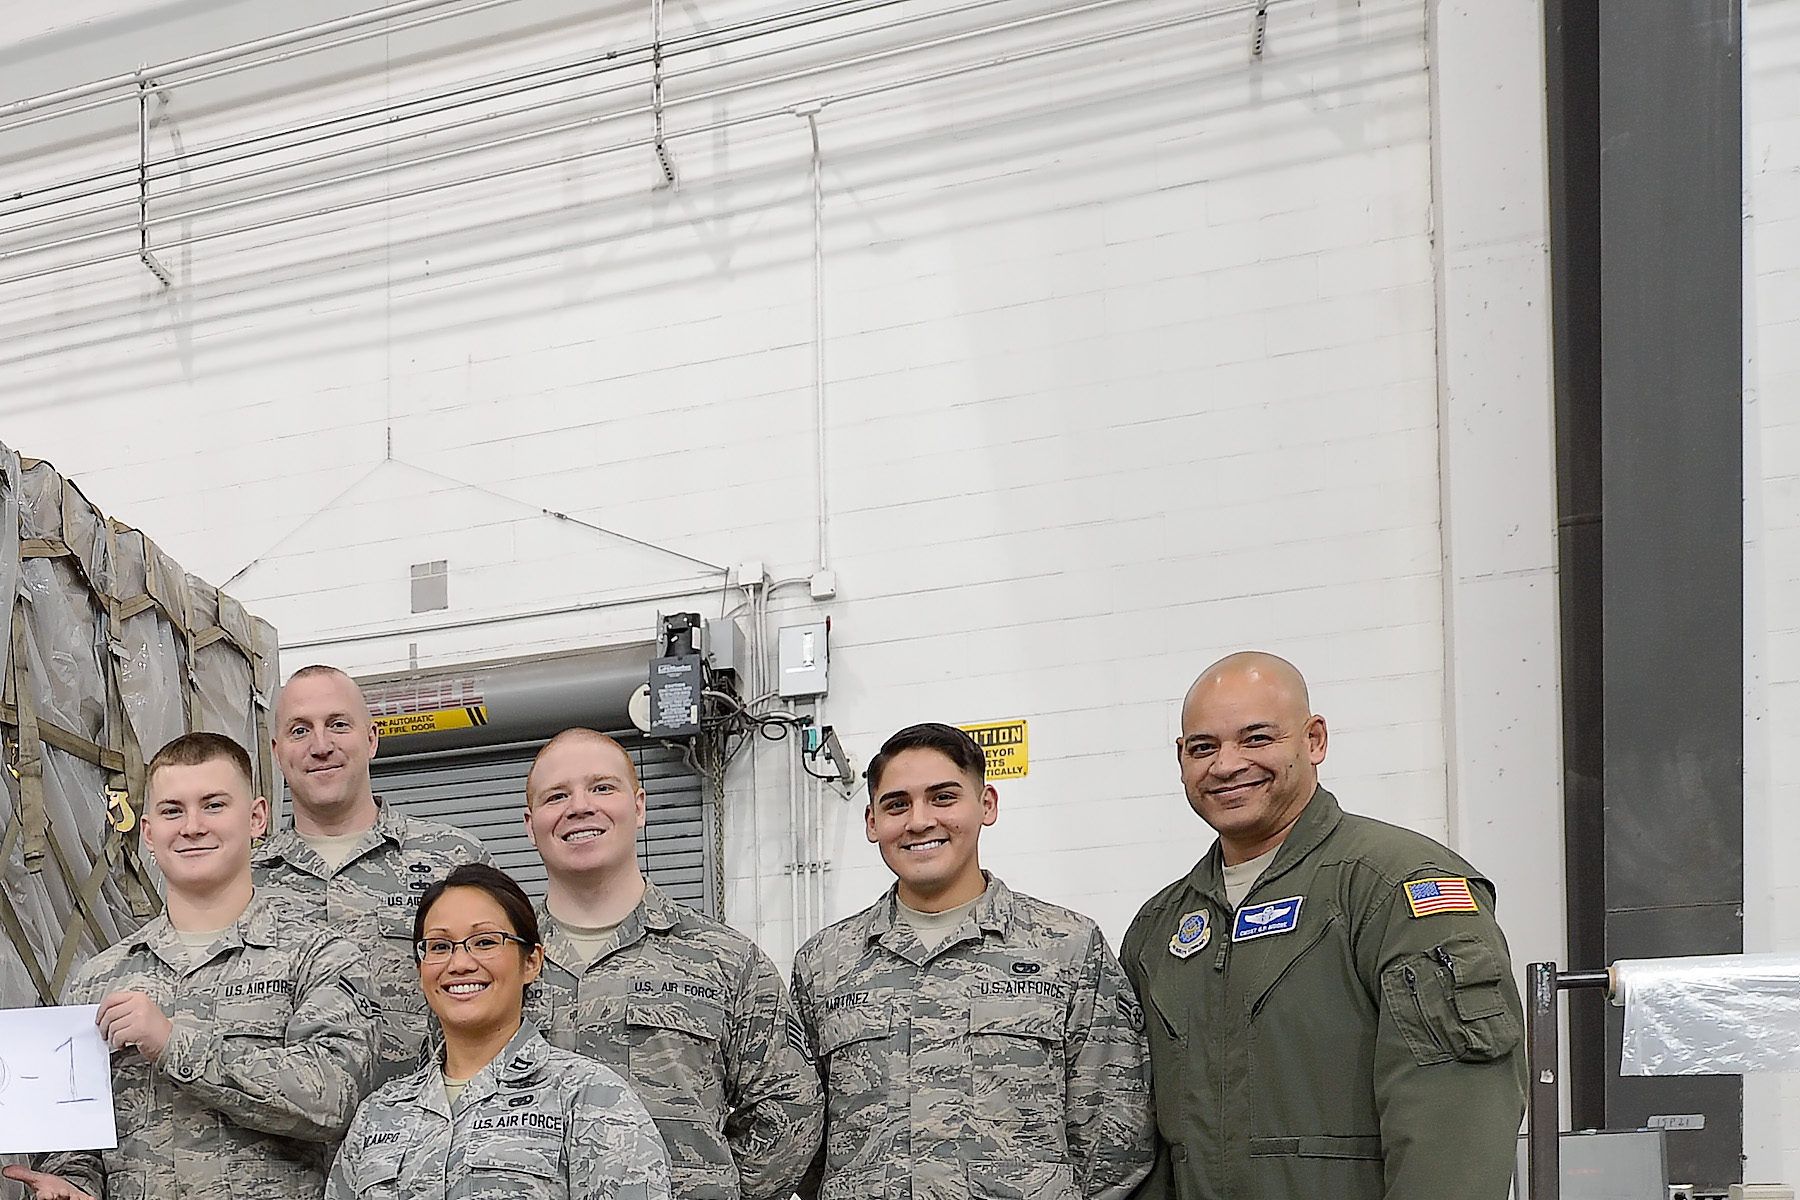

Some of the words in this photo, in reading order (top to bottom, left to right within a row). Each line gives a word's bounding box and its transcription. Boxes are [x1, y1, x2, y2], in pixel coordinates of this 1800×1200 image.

[389, 714, 434, 726] AUTOMATIC
[411, 722, 436, 732] DOOR
[968, 726, 1021, 745] UTION
[986, 748, 1014, 758] EYOR
[986, 766, 1023, 777] TICALLY
[246, 981, 265, 994] AIR
[634, 981, 653, 992] U.S.
[661, 981, 678, 993] AIR
[684, 984, 719, 1000] FORCE
[1006, 980, 1026, 994] AIR
[495, 1115, 519, 1128] AIR
[521, 1112, 562, 1131] FORCE
